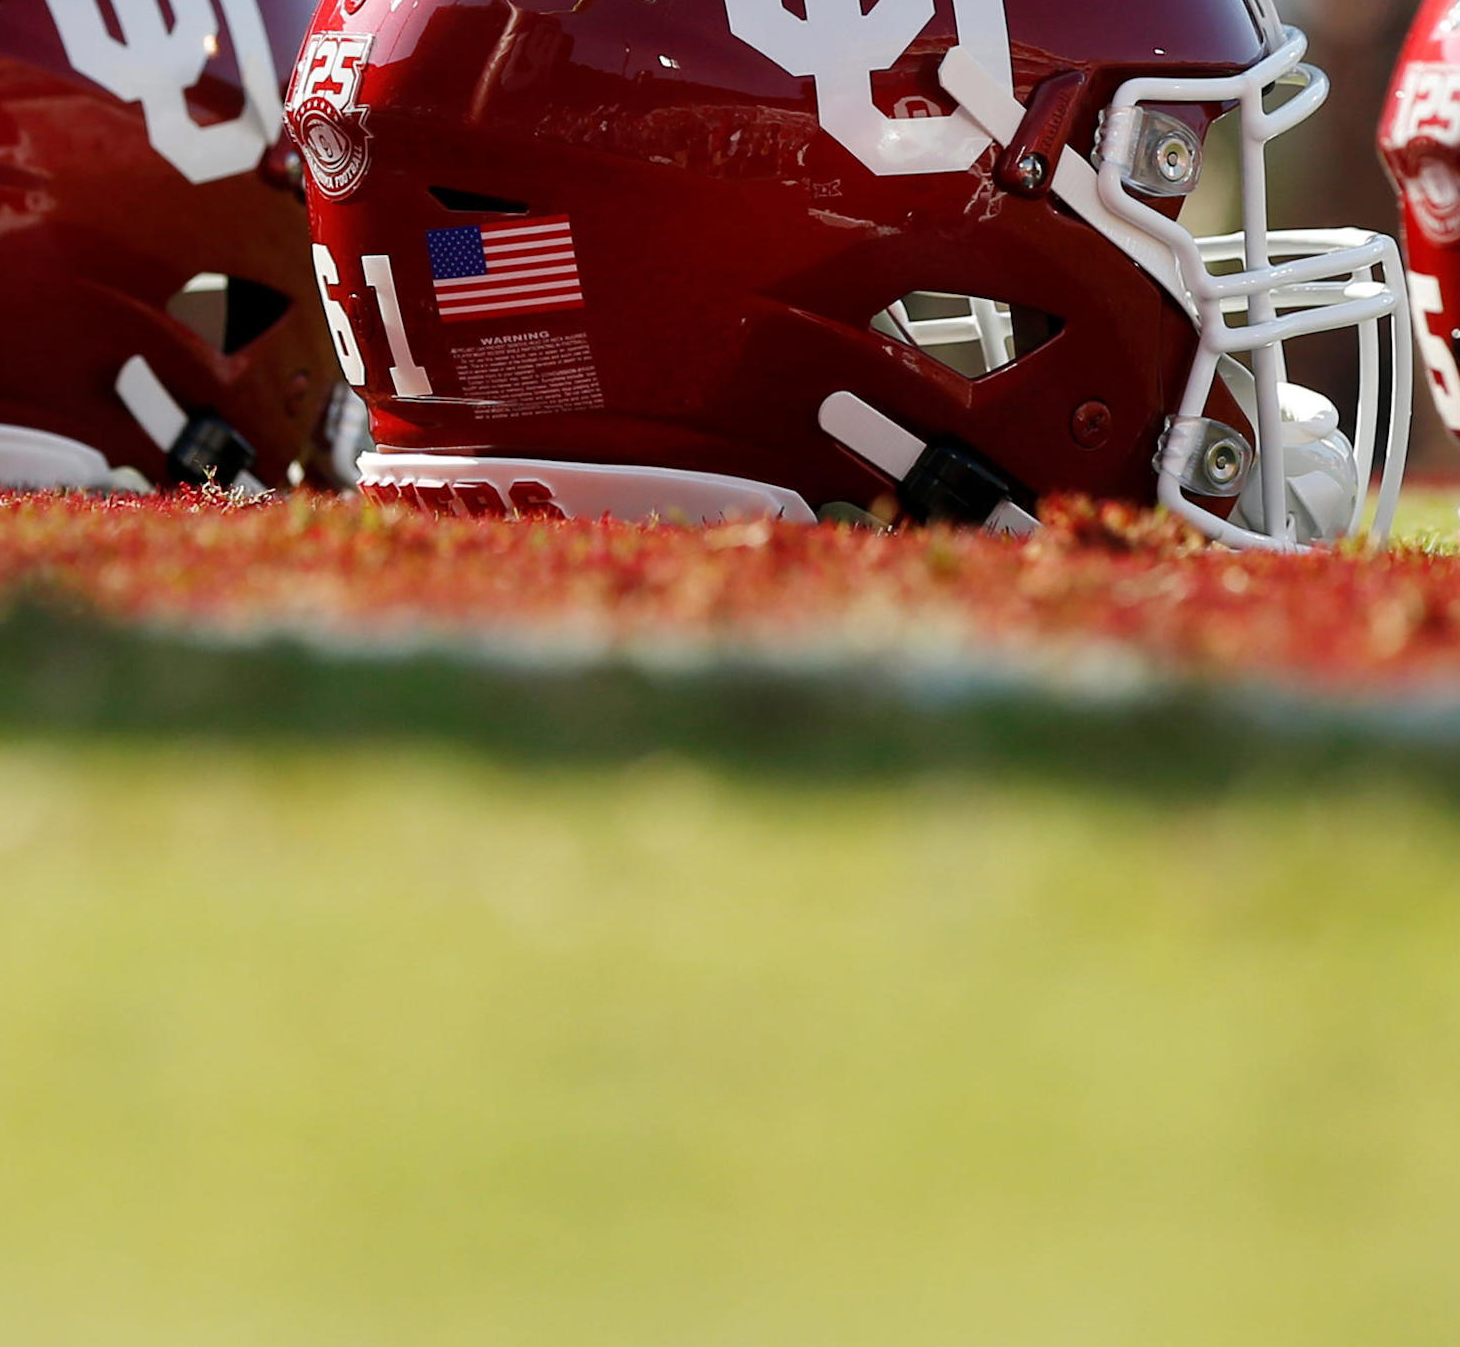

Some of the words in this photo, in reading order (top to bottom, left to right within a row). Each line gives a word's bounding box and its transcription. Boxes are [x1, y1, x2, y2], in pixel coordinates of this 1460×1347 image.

[293, 33, 374, 113] 125
[311, 243, 434, 397] 61
[480, 330, 551, 346] WARNING
